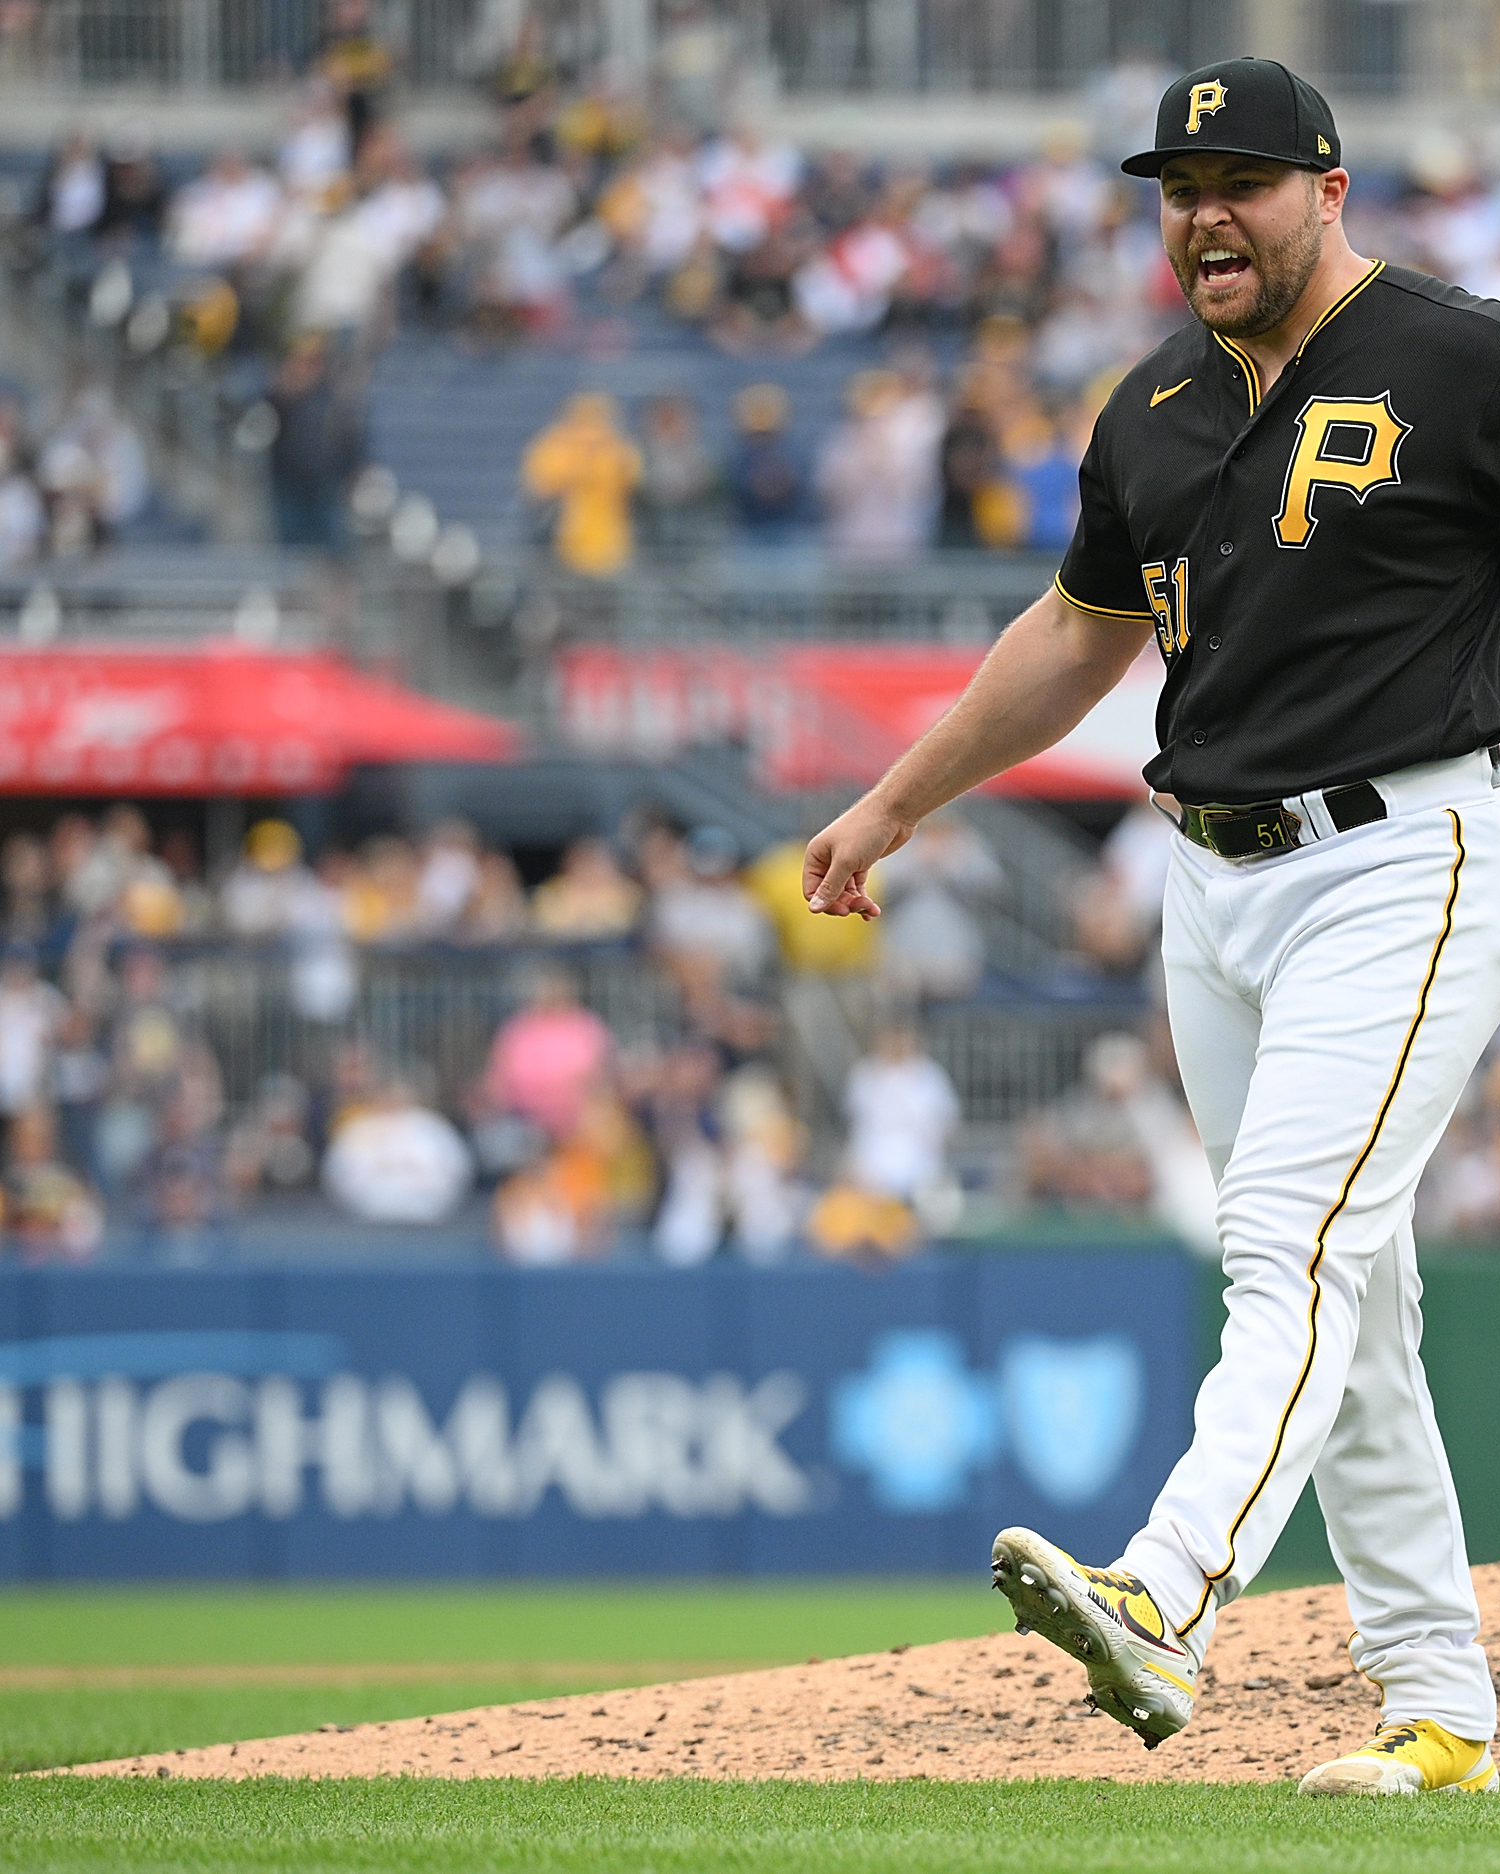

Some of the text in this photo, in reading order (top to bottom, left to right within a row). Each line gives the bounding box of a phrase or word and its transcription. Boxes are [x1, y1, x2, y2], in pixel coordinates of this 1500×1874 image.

[1186, 78, 1228, 134] P
[1271, 390, 1413, 549] P
[1141, 556, 1191, 657] 51
[1257, 822, 1286, 848] 51
[0, 1370, 806, 1521] HIGHMARK
